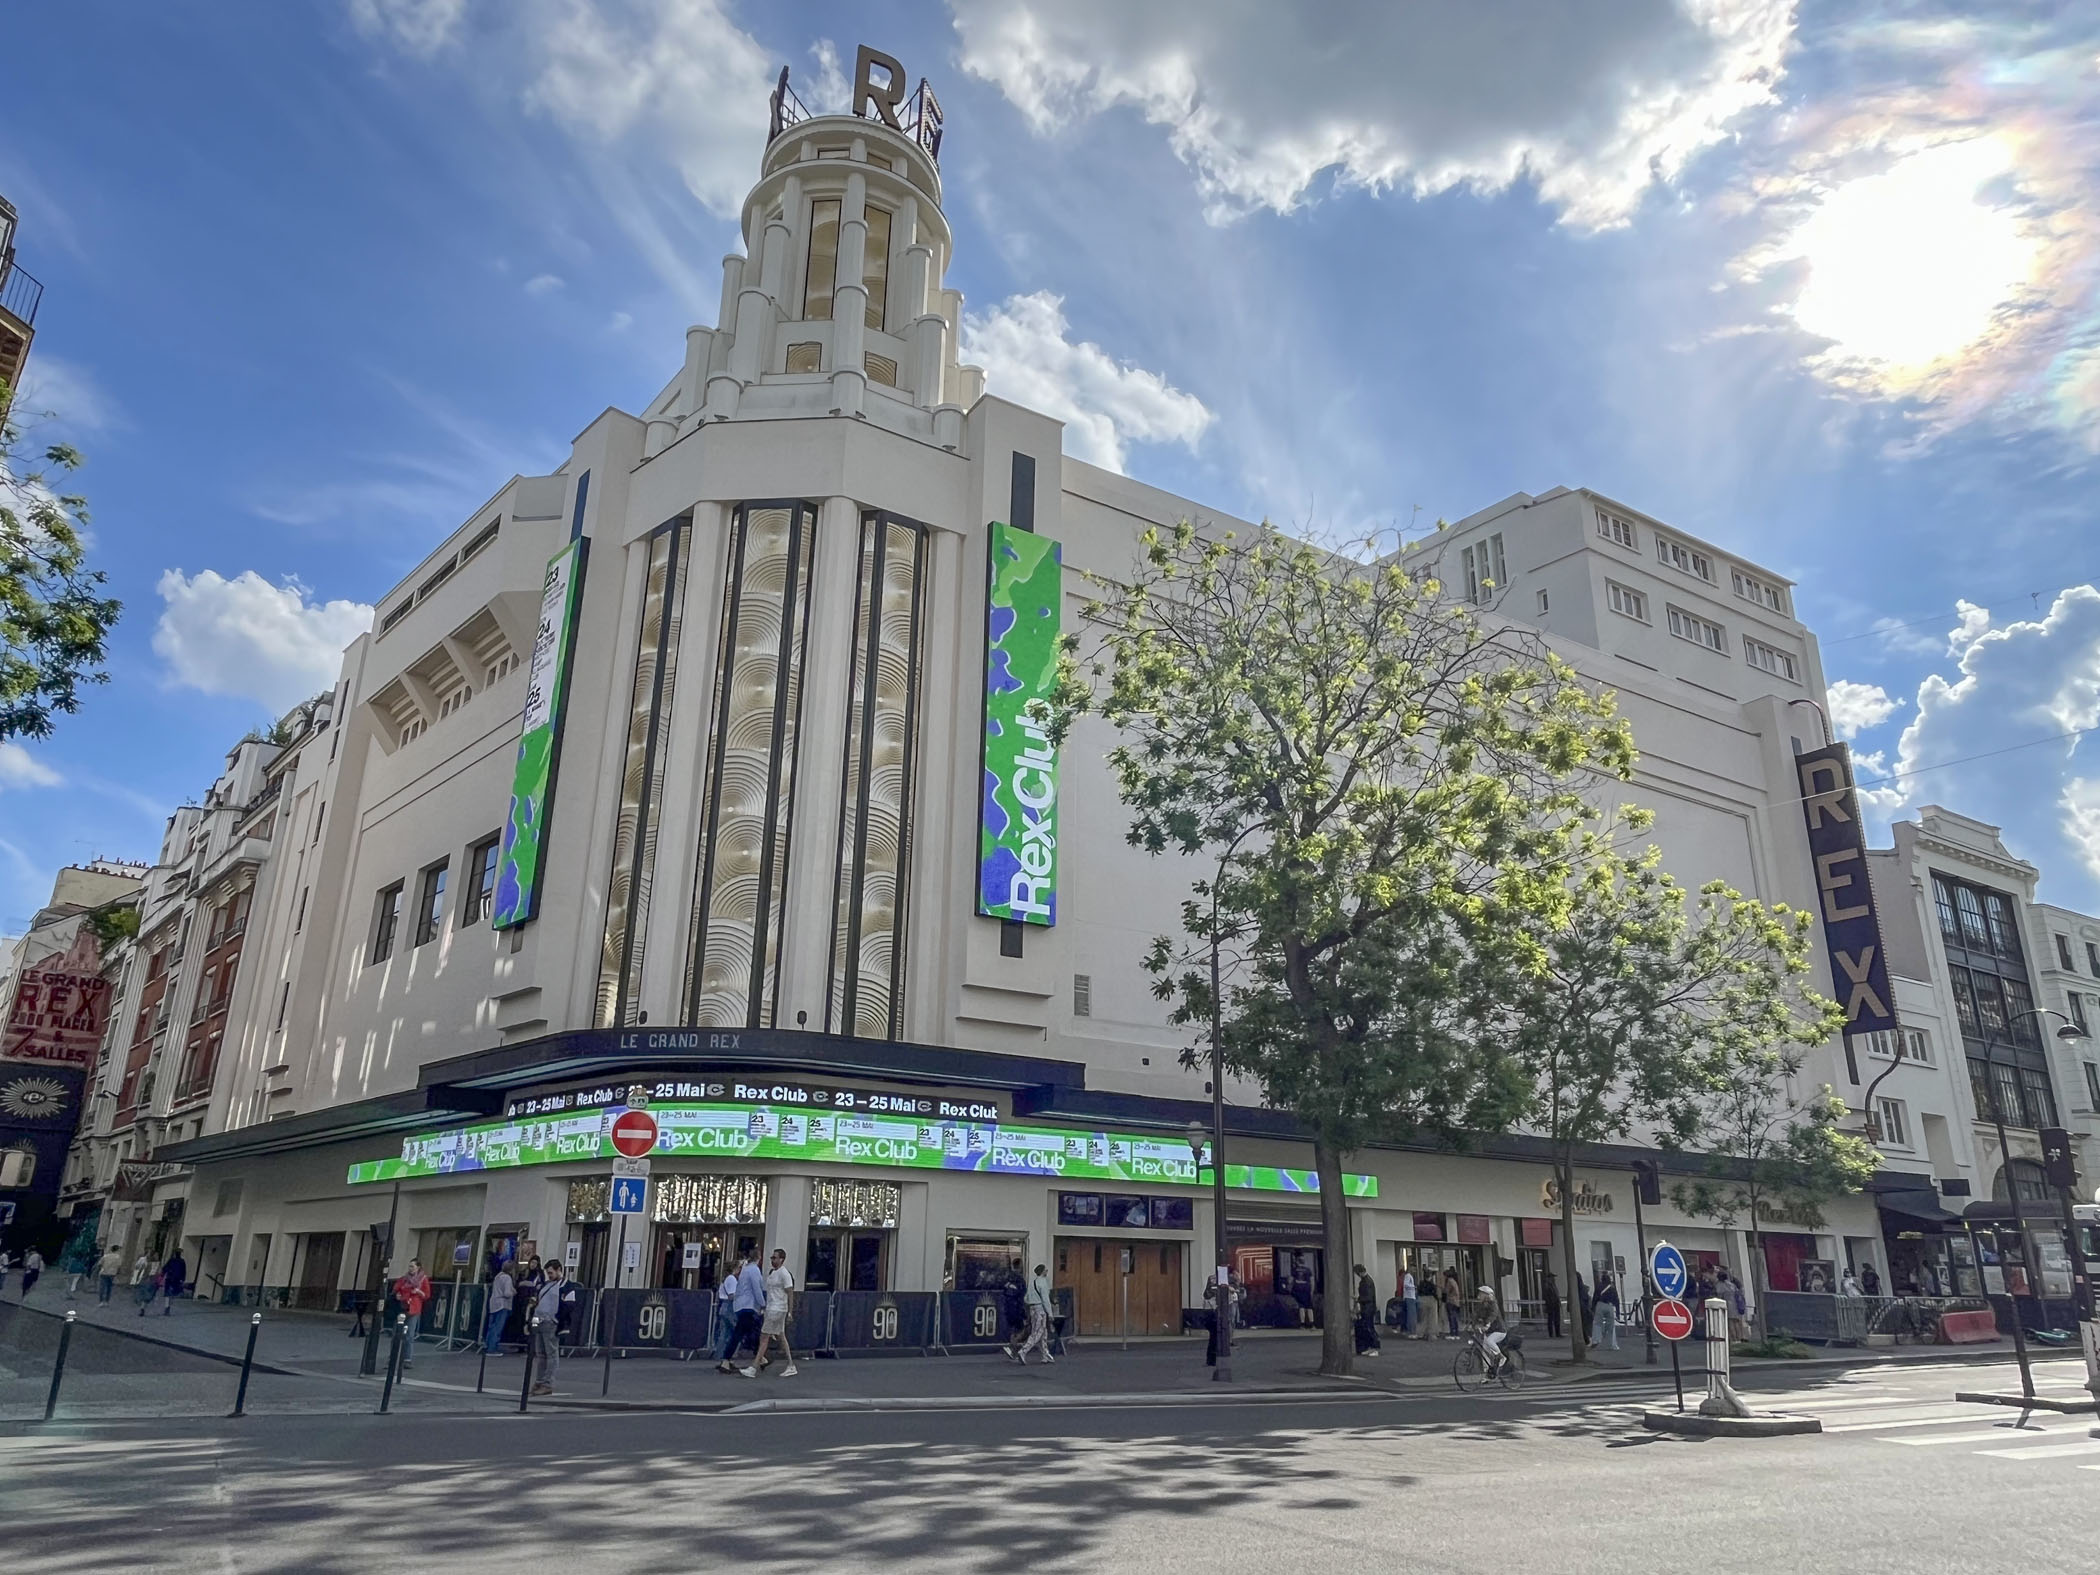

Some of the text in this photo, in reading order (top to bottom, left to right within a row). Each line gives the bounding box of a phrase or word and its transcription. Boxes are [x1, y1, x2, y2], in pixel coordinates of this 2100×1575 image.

[537, 619, 551, 640] 24
[526, 687, 541, 708] 25
[1009, 813, 1053, 916] Rex
[1801, 758, 1889, 1022] REX
[20, 969, 105, 990] LE GRAND
[16, 984, 104, 1017] REX
[620, 1033, 741, 1049] LE GRAND REX
[23, 1045, 88, 1062] SALLES
[576, 1093, 592, 1106] Rex
[593, 1088, 613, 1103] Club
[676, 1083, 705, 1097] Mai
[734, 1084, 768, 1099] Rex
[771, 1087, 808, 1102] Club
[890, 1098, 916, 1112] Mai
[939, 1102, 967, 1116] Rex
[750, 1115, 764, 1124] 23
[780, 1116, 793, 1125] 24
[809, 1119, 821, 1127] 25
[656, 1128, 694, 1148] Rex
[697, 1127, 749, 1148] Club
[919, 1128, 930, 1136] 23
[484, 1145, 501, 1162] Rex
[500, 1142, 520, 1160] Club
[556, 1136, 576, 1154] Rex
[576, 1133, 600, 1152] Club
[836, 1136, 873, 1157] Rex
[875, 1138, 918, 1160] Club
[992, 1147, 1065, 1170] Rex Club
[1132, 1157, 1197, 1178] Rex Club
[638, 1305, 667, 1340] 90
[873, 1306, 898, 1340] 90
[974, 1306, 997, 1337] 90
